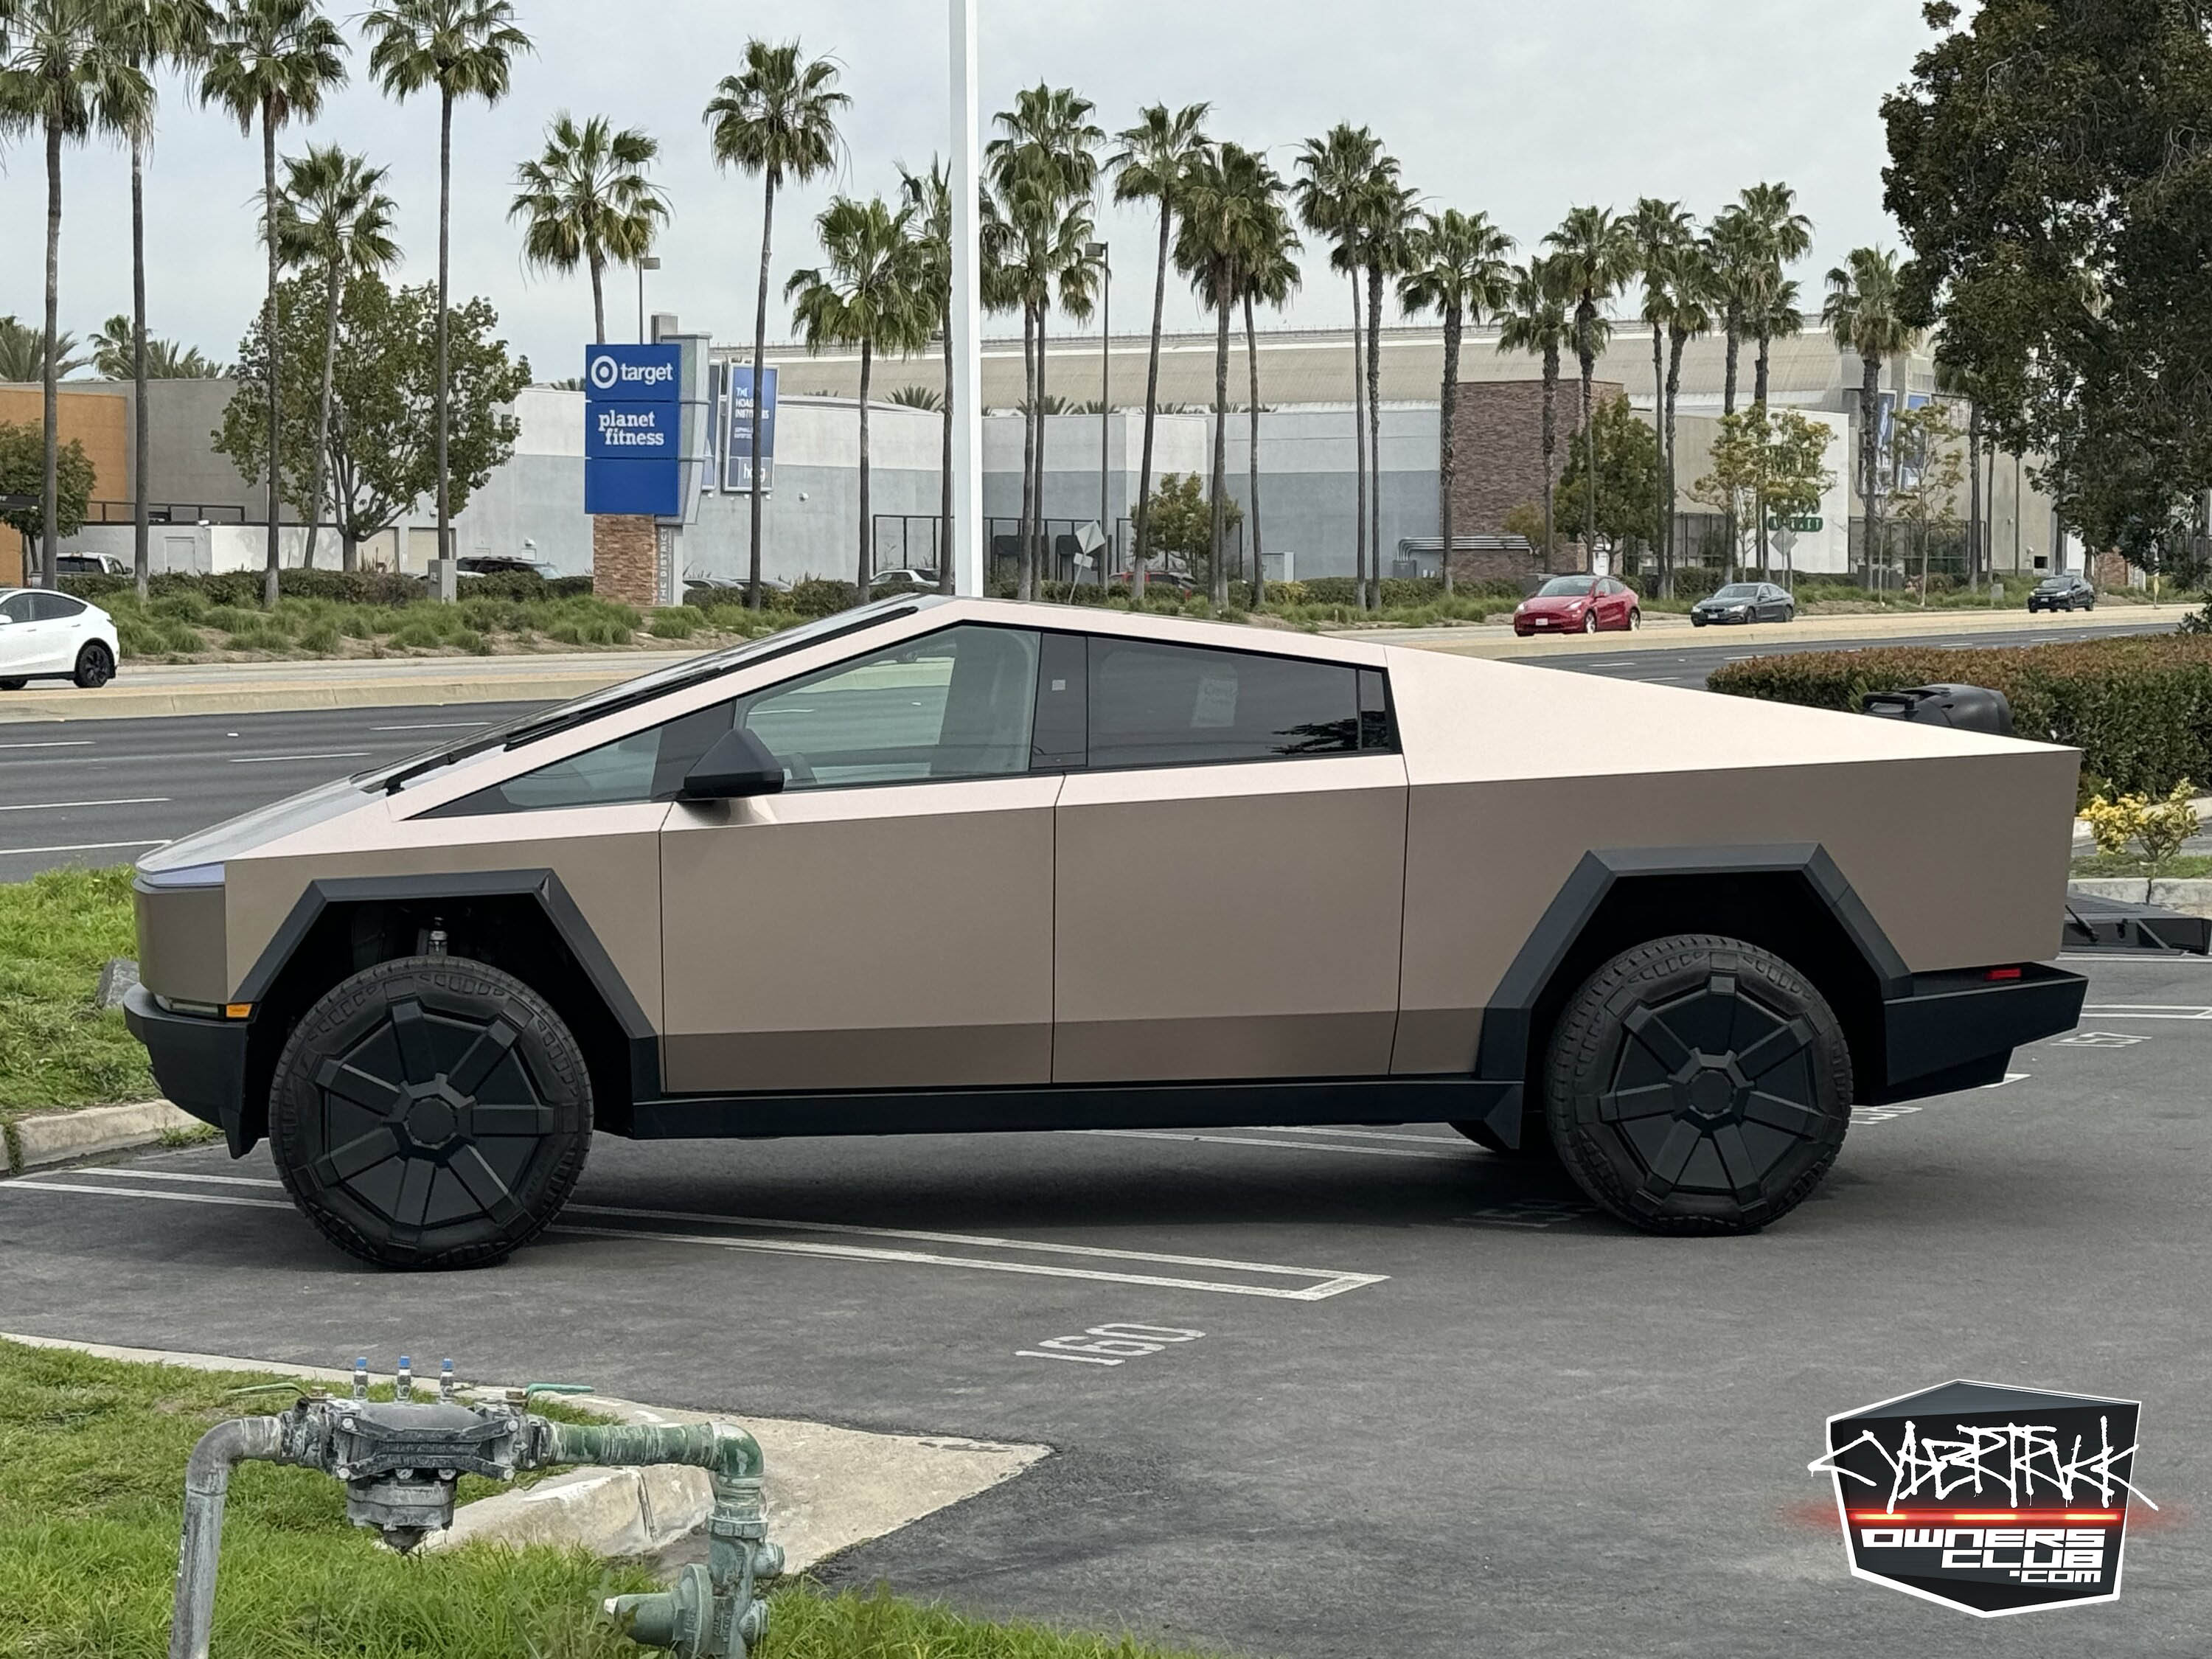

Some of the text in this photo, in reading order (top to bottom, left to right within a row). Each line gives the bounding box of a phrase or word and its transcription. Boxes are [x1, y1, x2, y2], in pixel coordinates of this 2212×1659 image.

[621, 362, 673, 385] target
[598, 409, 655, 431] planet
[605, 428, 664, 446] fitness
